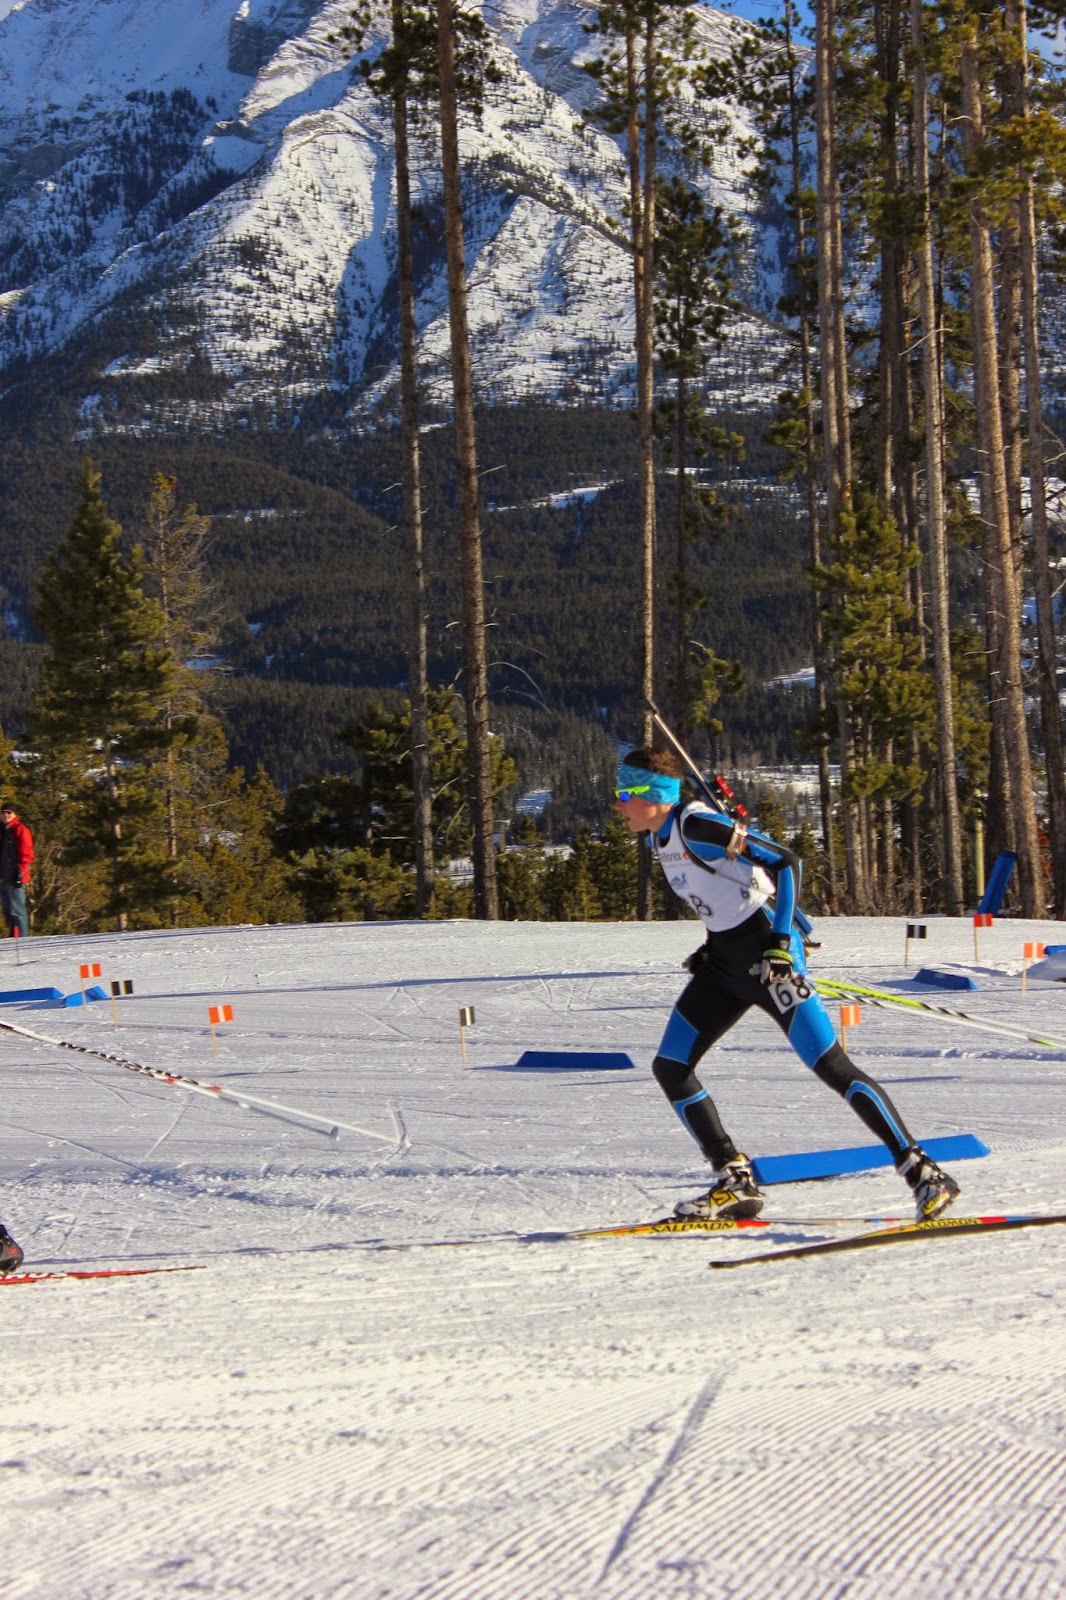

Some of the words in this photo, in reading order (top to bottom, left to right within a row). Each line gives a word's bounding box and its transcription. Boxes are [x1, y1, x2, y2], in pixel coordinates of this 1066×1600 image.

[775, 971, 811, 1007] 68
[649, 1222, 735, 1234] SALOMON
[915, 1218, 978, 1230] SALOMON
